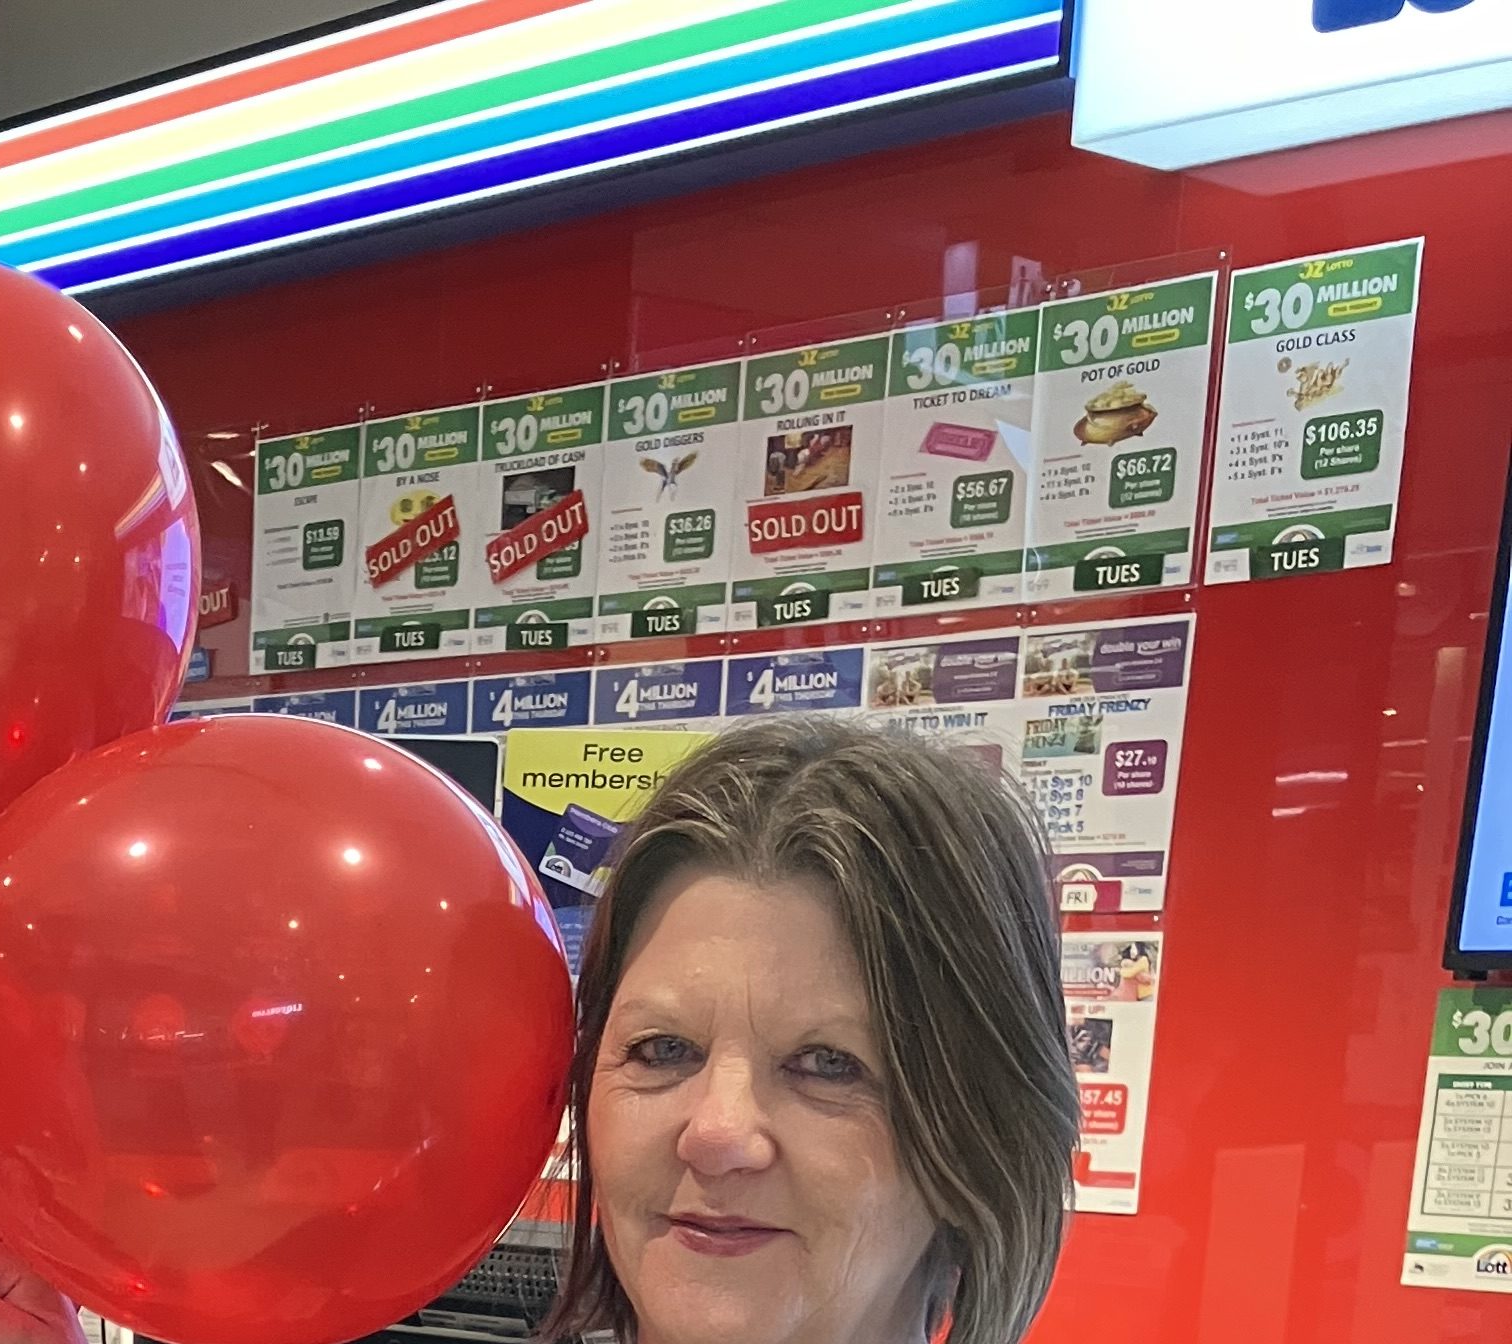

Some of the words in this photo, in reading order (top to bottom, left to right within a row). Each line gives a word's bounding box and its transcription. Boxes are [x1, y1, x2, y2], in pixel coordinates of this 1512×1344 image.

[1244, 282, 1314, 335] $30
[1317, 273, 1398, 304] MILLION
[1053, 314, 1119, 365] $30
[1121, 307, 1194, 335] MILLION
[1276, 335, 1312, 353] GOLD
[1316, 329, 1356, 347] CLASS
[902, 342, 961, 390] $30
[963, 336, 1030, 361] MILLION
[1081, 367, 1105, 383] POT
[1108, 364, 1123, 379] OF
[1126, 359, 1160, 375] GOLD
[755, 369, 810, 414] $30
[812, 364, 874, 388] MILLION
[913, 392, 949, 410] TICKET
[951, 389, 967, 404] TO
[969, 384, 1012, 401] DREAM
[618, 392, 668, 435] $30
[670, 387, 727, 410] MILLION
[777, 413, 818, 430] ROLLING
[821, 412, 834, 425] IN
[835, 410, 846, 423] IT
[490, 414, 538, 455] $30
[540, 411, 593, 432] MILLION
[635, 437, 661, 453] GOLD
[663, 432, 705, 448] DIGGERS
[1305, 417, 1378, 446] $106.35
[305, 450, 350, 467] MILLION
[373, 433, 416, 472] $30
[417, 431, 468, 449] MILLION
[495, 455, 546, 473] TRUCKLOAD
[547, 453, 560, 465] OF
[561, 451, 585, 463] CASH
[1117, 454, 1172, 480] $66.72
[956, 478, 1008, 501] $56.67
[750, 514, 806, 543] SOLD
[812, 505, 862, 534] OUT
[368, 539, 412, 578] SOLD
[415, 506, 455, 547] OUT
[489, 534, 536, 574] SOLD
[541, 501, 584, 543] OUT
[1271, 548, 1320, 572] TUES
[1095, 563, 1140, 585] TUES
[921, 577, 961, 599] TUES
[199, 587, 228, 615] OUT
[774, 600, 812, 621] TUES
[647, 615, 680, 633] TUES
[394, 631, 424, 647] TUES
[520, 630, 553, 646] TUES
[277, 651, 304, 665] TUES
[640, 682, 697, 701] MILLION
[747, 668, 775, 709] $4
[775, 671, 837, 691] MILLION
[397, 702, 447, 720] MILLION
[514, 692, 568, 710] MILLION
[1048, 702, 1096, 717] FRIDAY
[1099, 698, 1151, 715] FRENZY
[944, 714, 971, 728] WIN
[975, 712, 988, 726] IT
[583, 743, 643, 762] Free
[1051, 776, 1073, 791] Sys
[1079, 774, 1093, 787] 10
[1066, 891, 1088, 904] FRI
[1476, 1259, 1507, 1274] Lott
